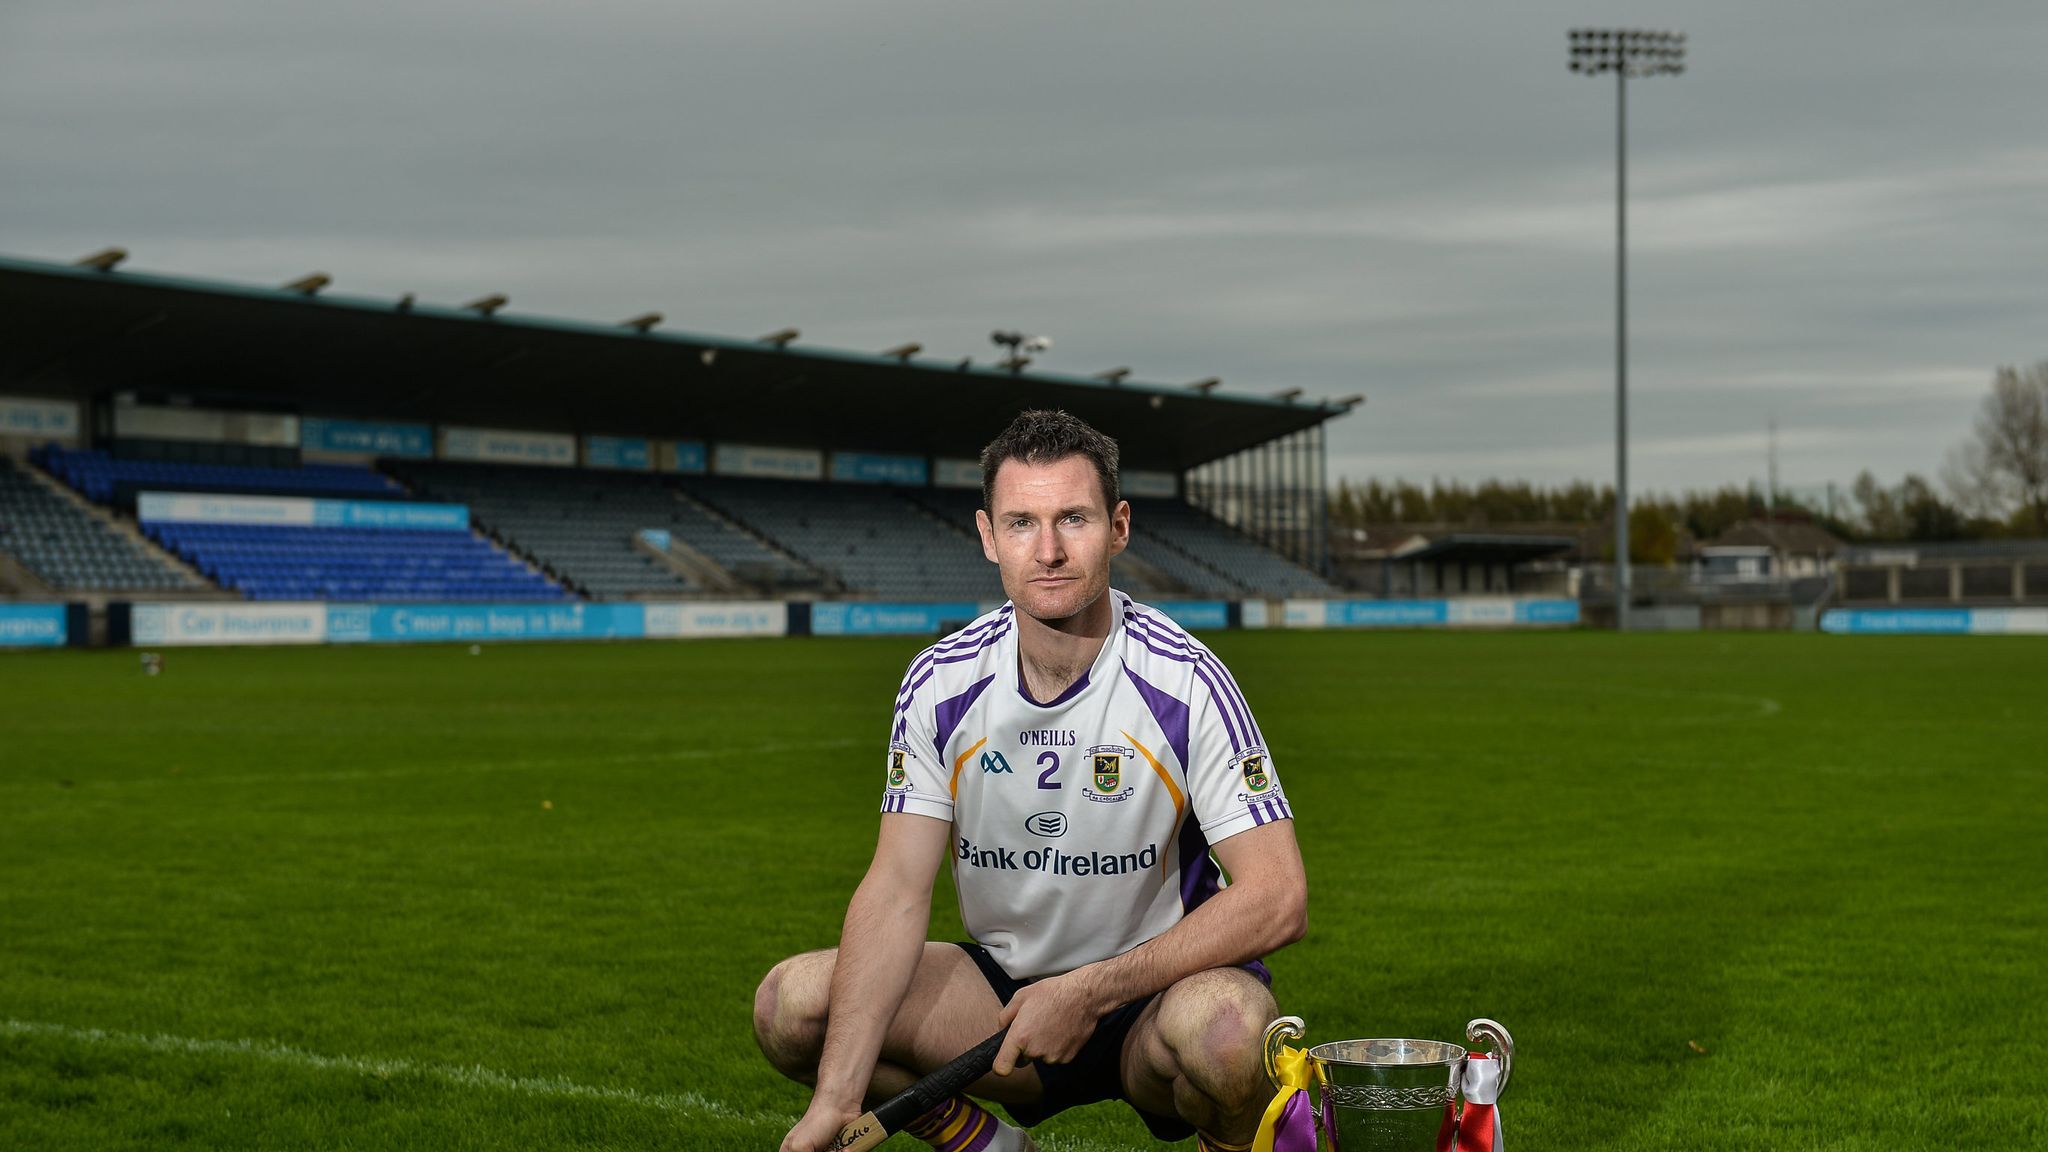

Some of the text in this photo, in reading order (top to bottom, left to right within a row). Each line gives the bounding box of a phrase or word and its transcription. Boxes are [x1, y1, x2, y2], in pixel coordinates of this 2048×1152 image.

[1019, 729, 1076, 746] O'NEILLS
[1036, 750, 1062, 790] 2
[958, 837, 1157, 877] Bank of Ireland
